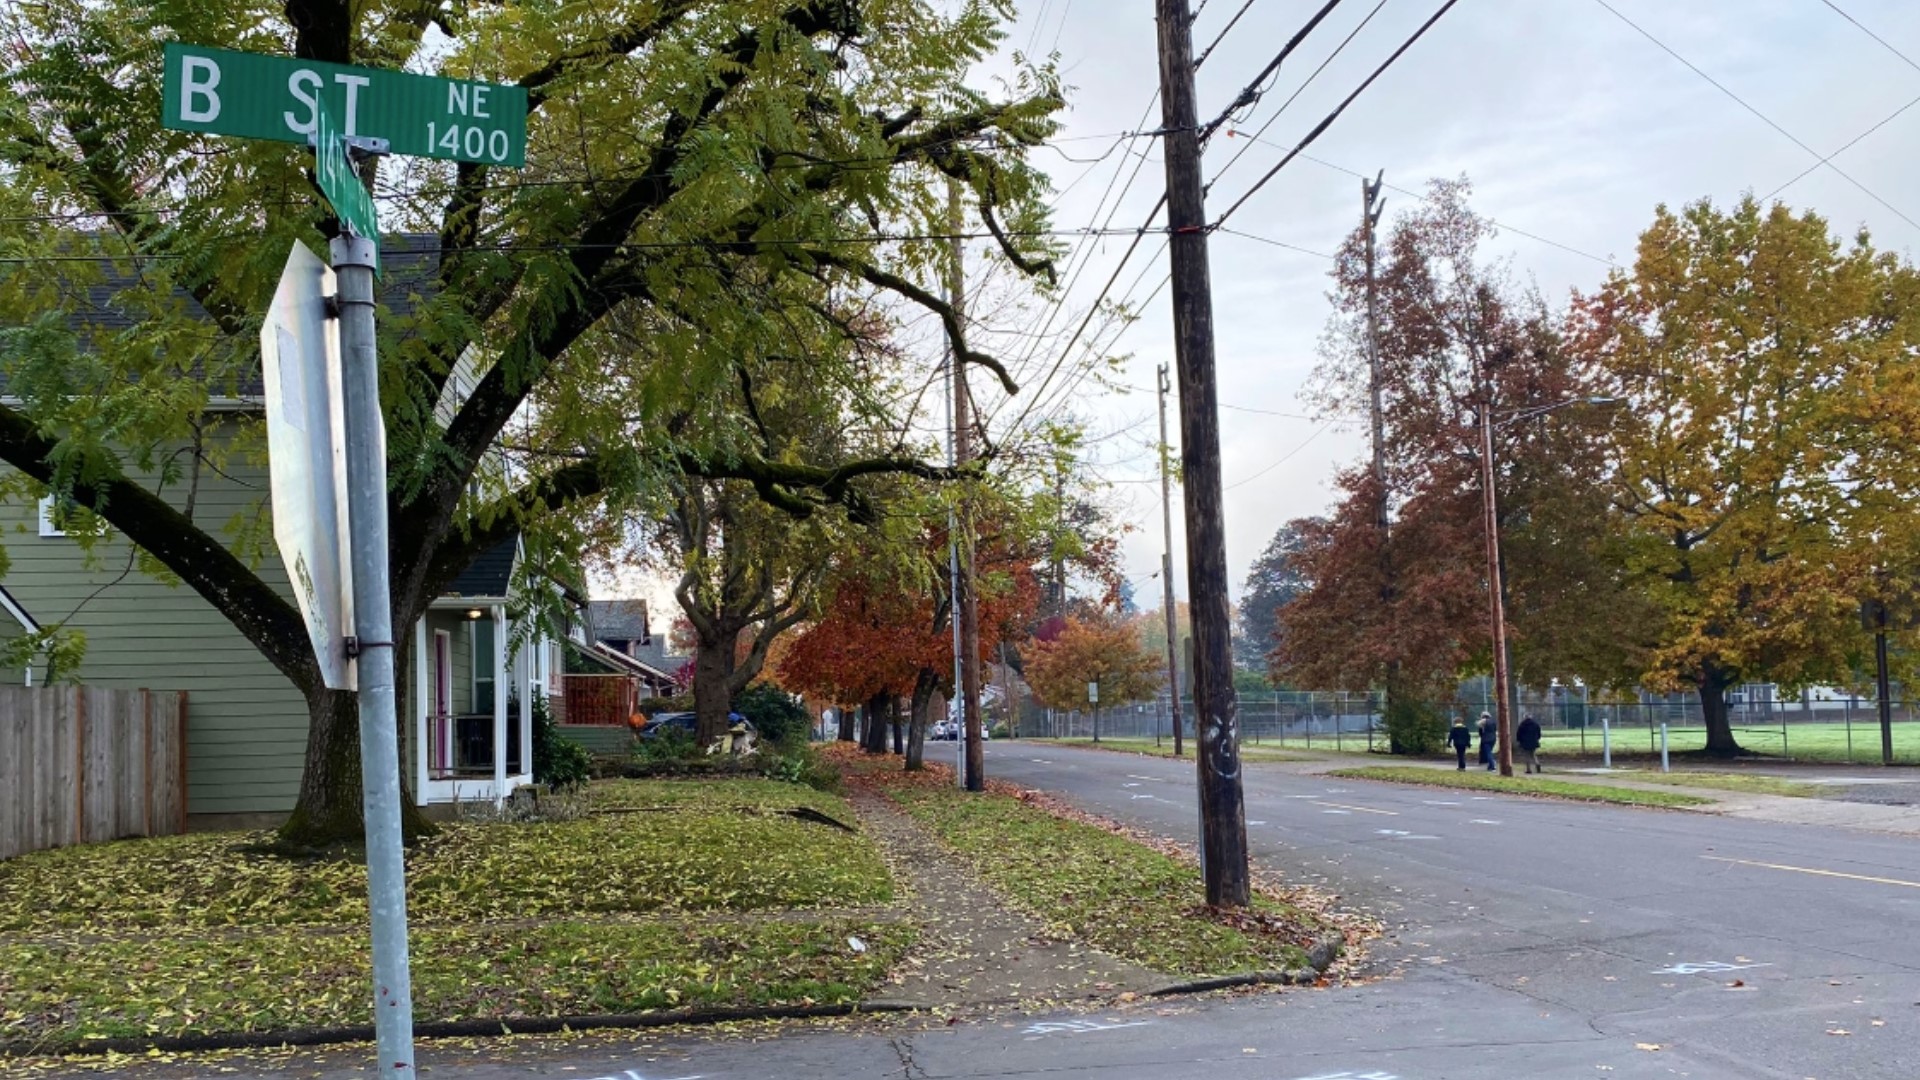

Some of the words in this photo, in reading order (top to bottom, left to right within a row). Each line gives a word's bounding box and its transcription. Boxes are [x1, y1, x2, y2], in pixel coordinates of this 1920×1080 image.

[180, 55, 221, 122] B
[284, 69, 370, 136] ST
[447, 82, 491, 118] NE
[427, 121, 509, 161] 1400
